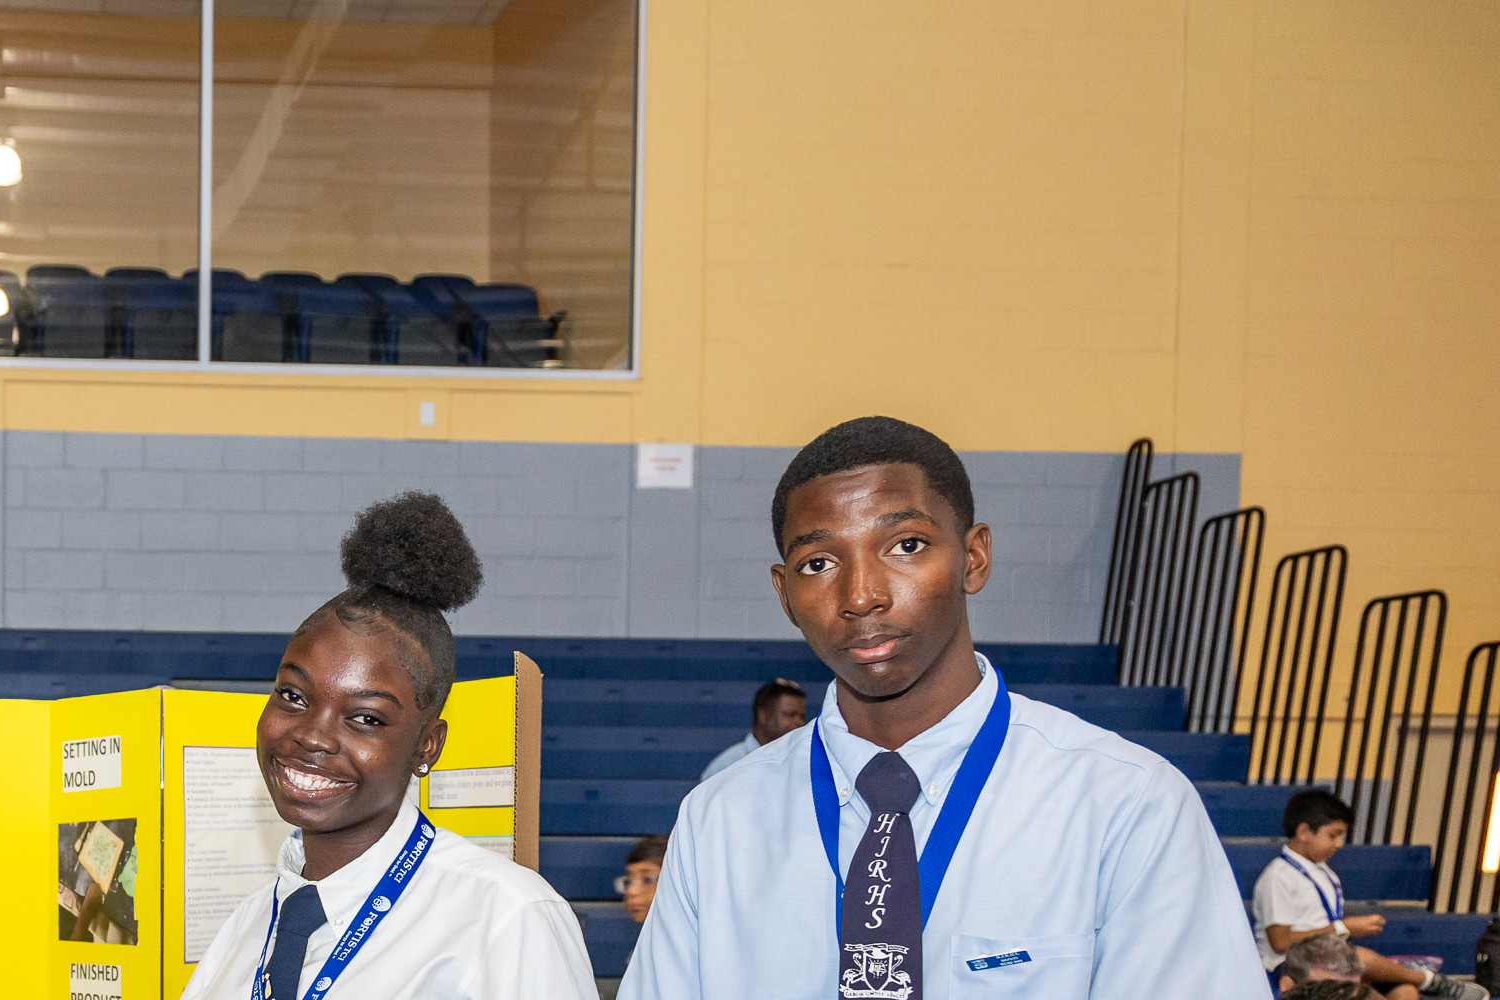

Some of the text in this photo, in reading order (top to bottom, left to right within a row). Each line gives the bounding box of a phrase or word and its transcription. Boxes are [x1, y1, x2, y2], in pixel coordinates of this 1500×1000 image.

[63, 737, 120, 759] SETTING IN
[64, 770, 95, 788] MOLD
[70, 963, 119, 981] FINISHED
